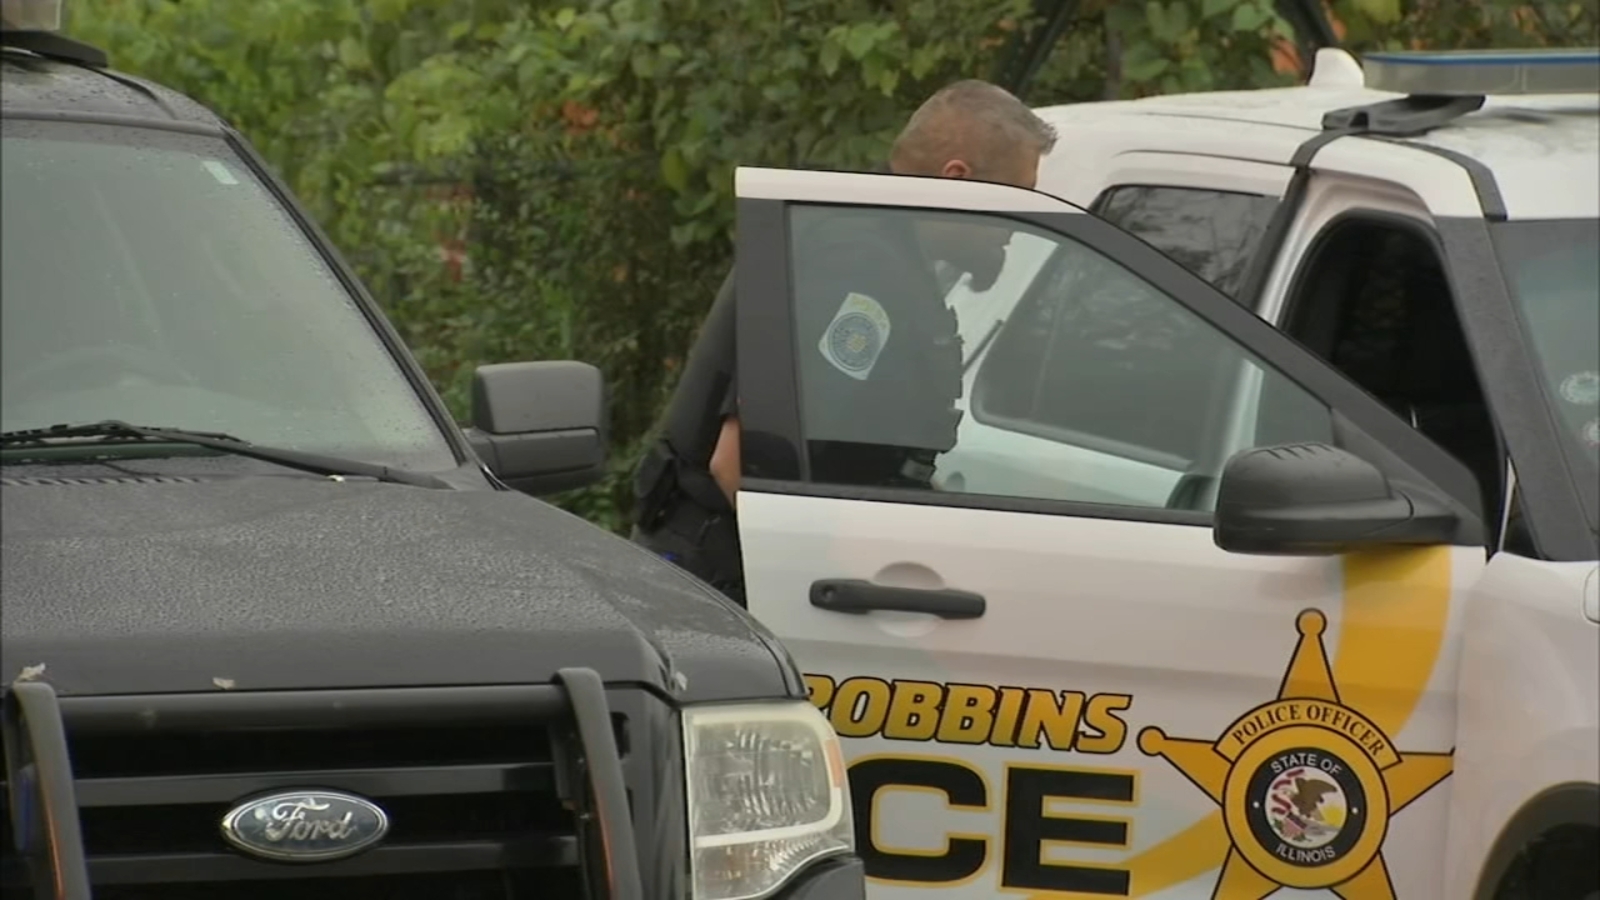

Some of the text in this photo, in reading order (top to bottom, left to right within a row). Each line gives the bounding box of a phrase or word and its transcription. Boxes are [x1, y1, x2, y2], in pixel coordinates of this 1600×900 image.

[1232, 704, 1385, 756] POLICE OFFICER
[1271, 753, 1342, 776] STATE OF
[265, 797, 357, 841] Ford
[1276, 843, 1335, 862] ILLINOIS
